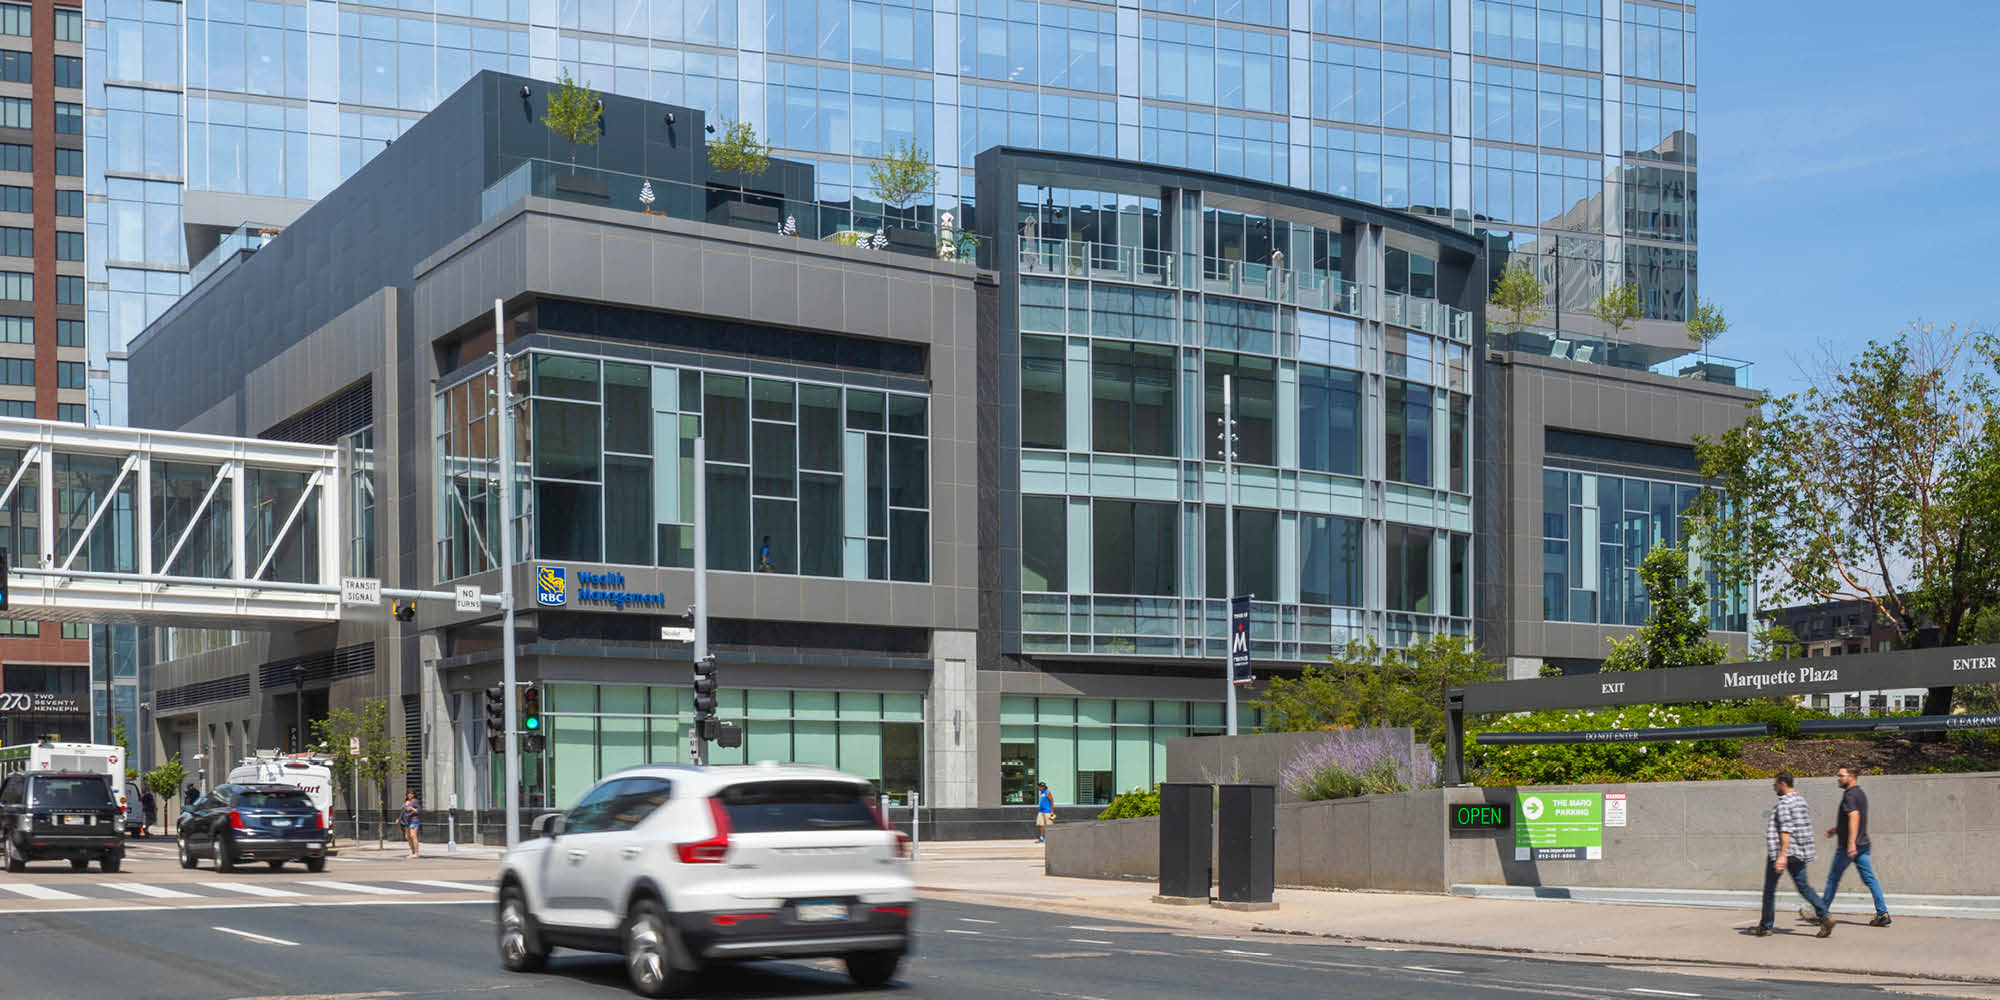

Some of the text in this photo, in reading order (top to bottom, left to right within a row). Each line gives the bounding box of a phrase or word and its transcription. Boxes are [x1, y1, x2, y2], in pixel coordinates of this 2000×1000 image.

[577, 571, 625, 585] Wealth
[346, 581, 377, 591] TRANSIT
[348, 593, 374, 601] SIGNAL
[462, 590, 474, 598] NO
[540, 593, 563, 602] RBC
[577, 588, 665, 606] Management
[1233, 631, 1248, 653] M
[1952, 656, 1997, 671] ENTER
[1723, 667, 1838, 690] Marquette Plaza
[1602, 683, 1625, 694] EXIT
[0, 693, 31, 711] 270
[1585, 731, 1639, 741] DO NOT ENTER
[1553, 799, 1568, 807] THE
[1457, 807, 1502, 825] OPEN
[1555, 808, 1590, 817] PARKING
